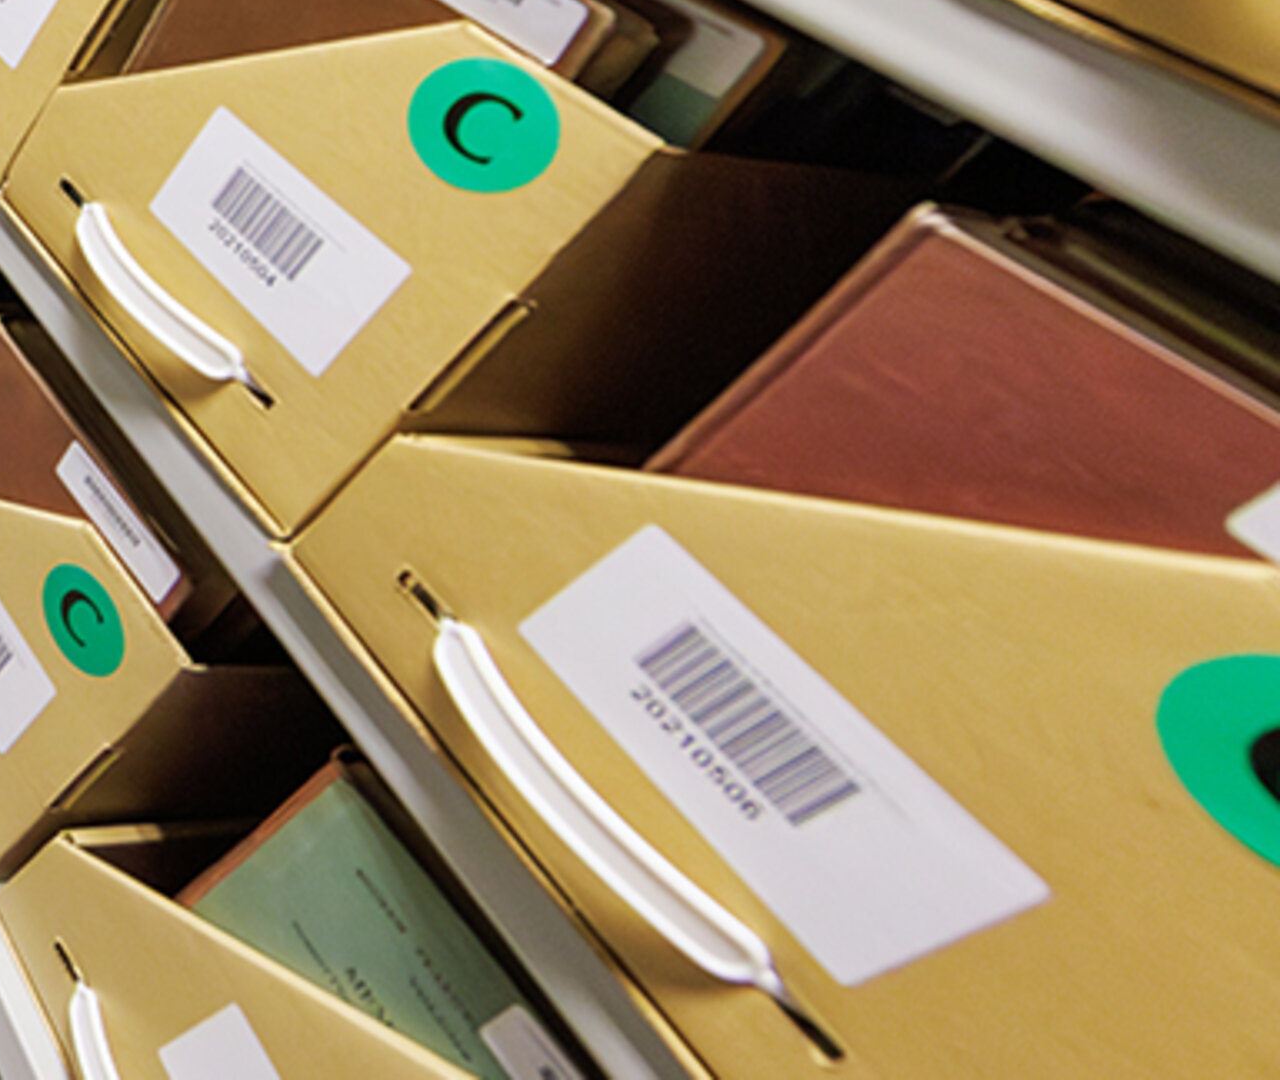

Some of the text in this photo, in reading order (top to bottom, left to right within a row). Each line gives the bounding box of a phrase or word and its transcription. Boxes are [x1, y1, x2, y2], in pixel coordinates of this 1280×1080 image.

[442, 92, 523, 165] C
[206, 219, 279, 288] 20210504
[60, 589, 104, 648] C
[628, 686, 767, 822] 20210506
